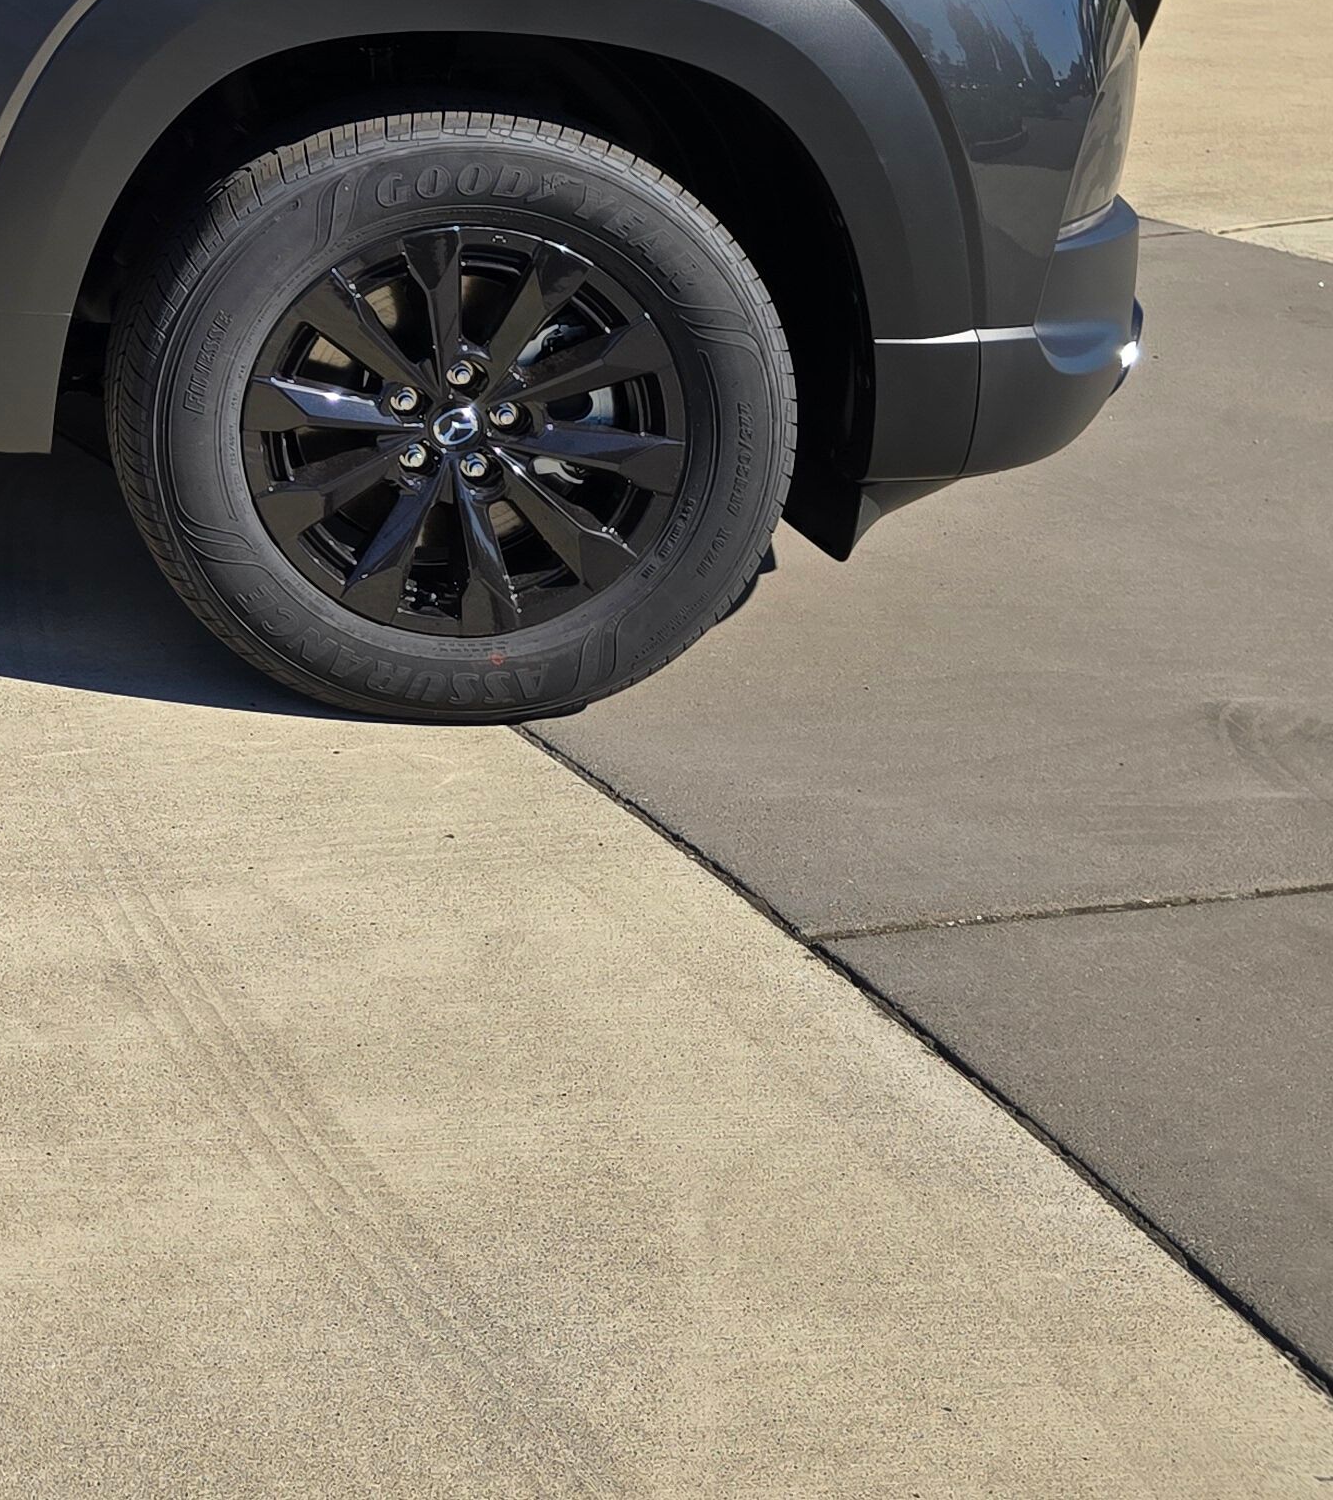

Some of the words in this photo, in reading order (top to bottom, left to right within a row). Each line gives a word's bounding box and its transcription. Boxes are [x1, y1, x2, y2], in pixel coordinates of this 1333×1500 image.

[376, 161, 705, 296] GOODYEAR
[183, 308, 233, 415] FINESSE
[235, 584, 550, 704] ASSURANCE
